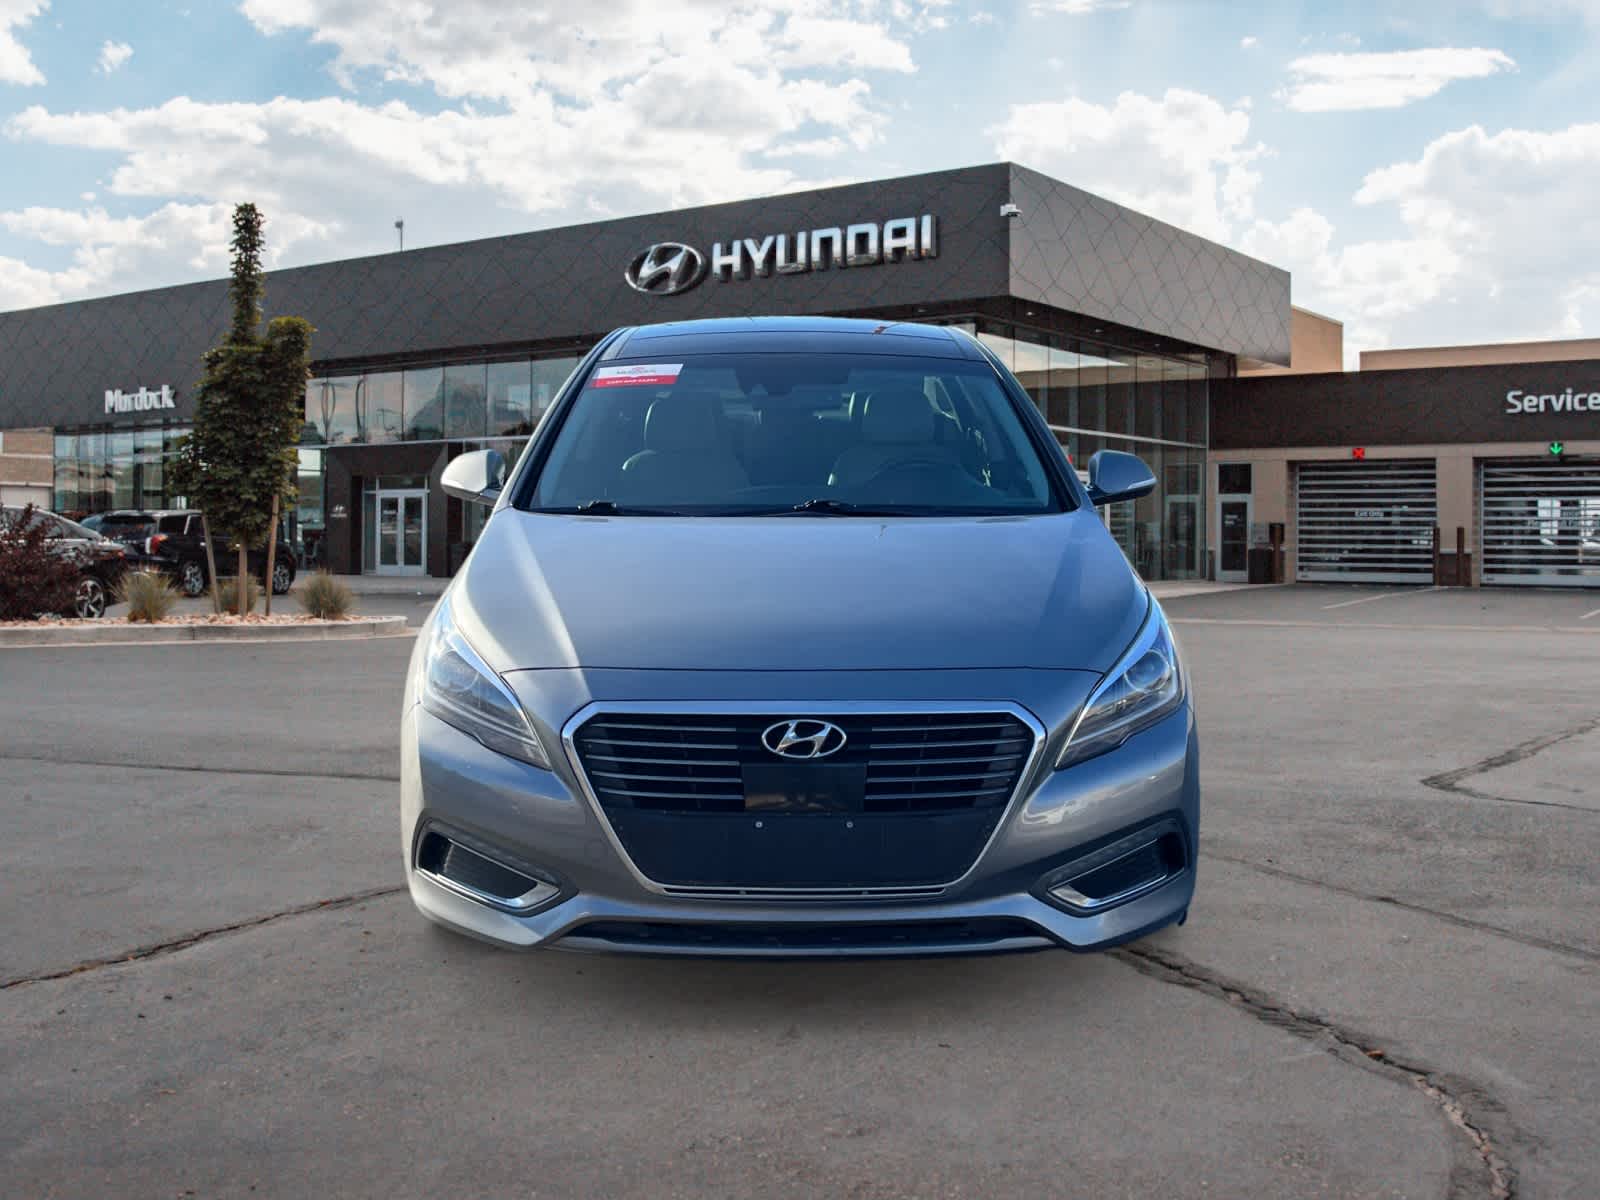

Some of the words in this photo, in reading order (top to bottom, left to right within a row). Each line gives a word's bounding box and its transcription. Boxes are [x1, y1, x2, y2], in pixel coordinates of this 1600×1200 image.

[711, 214, 937, 283] HYUNDAI
[104, 384, 176, 414] Murdock
[1505, 387, 1600, 414] Service
